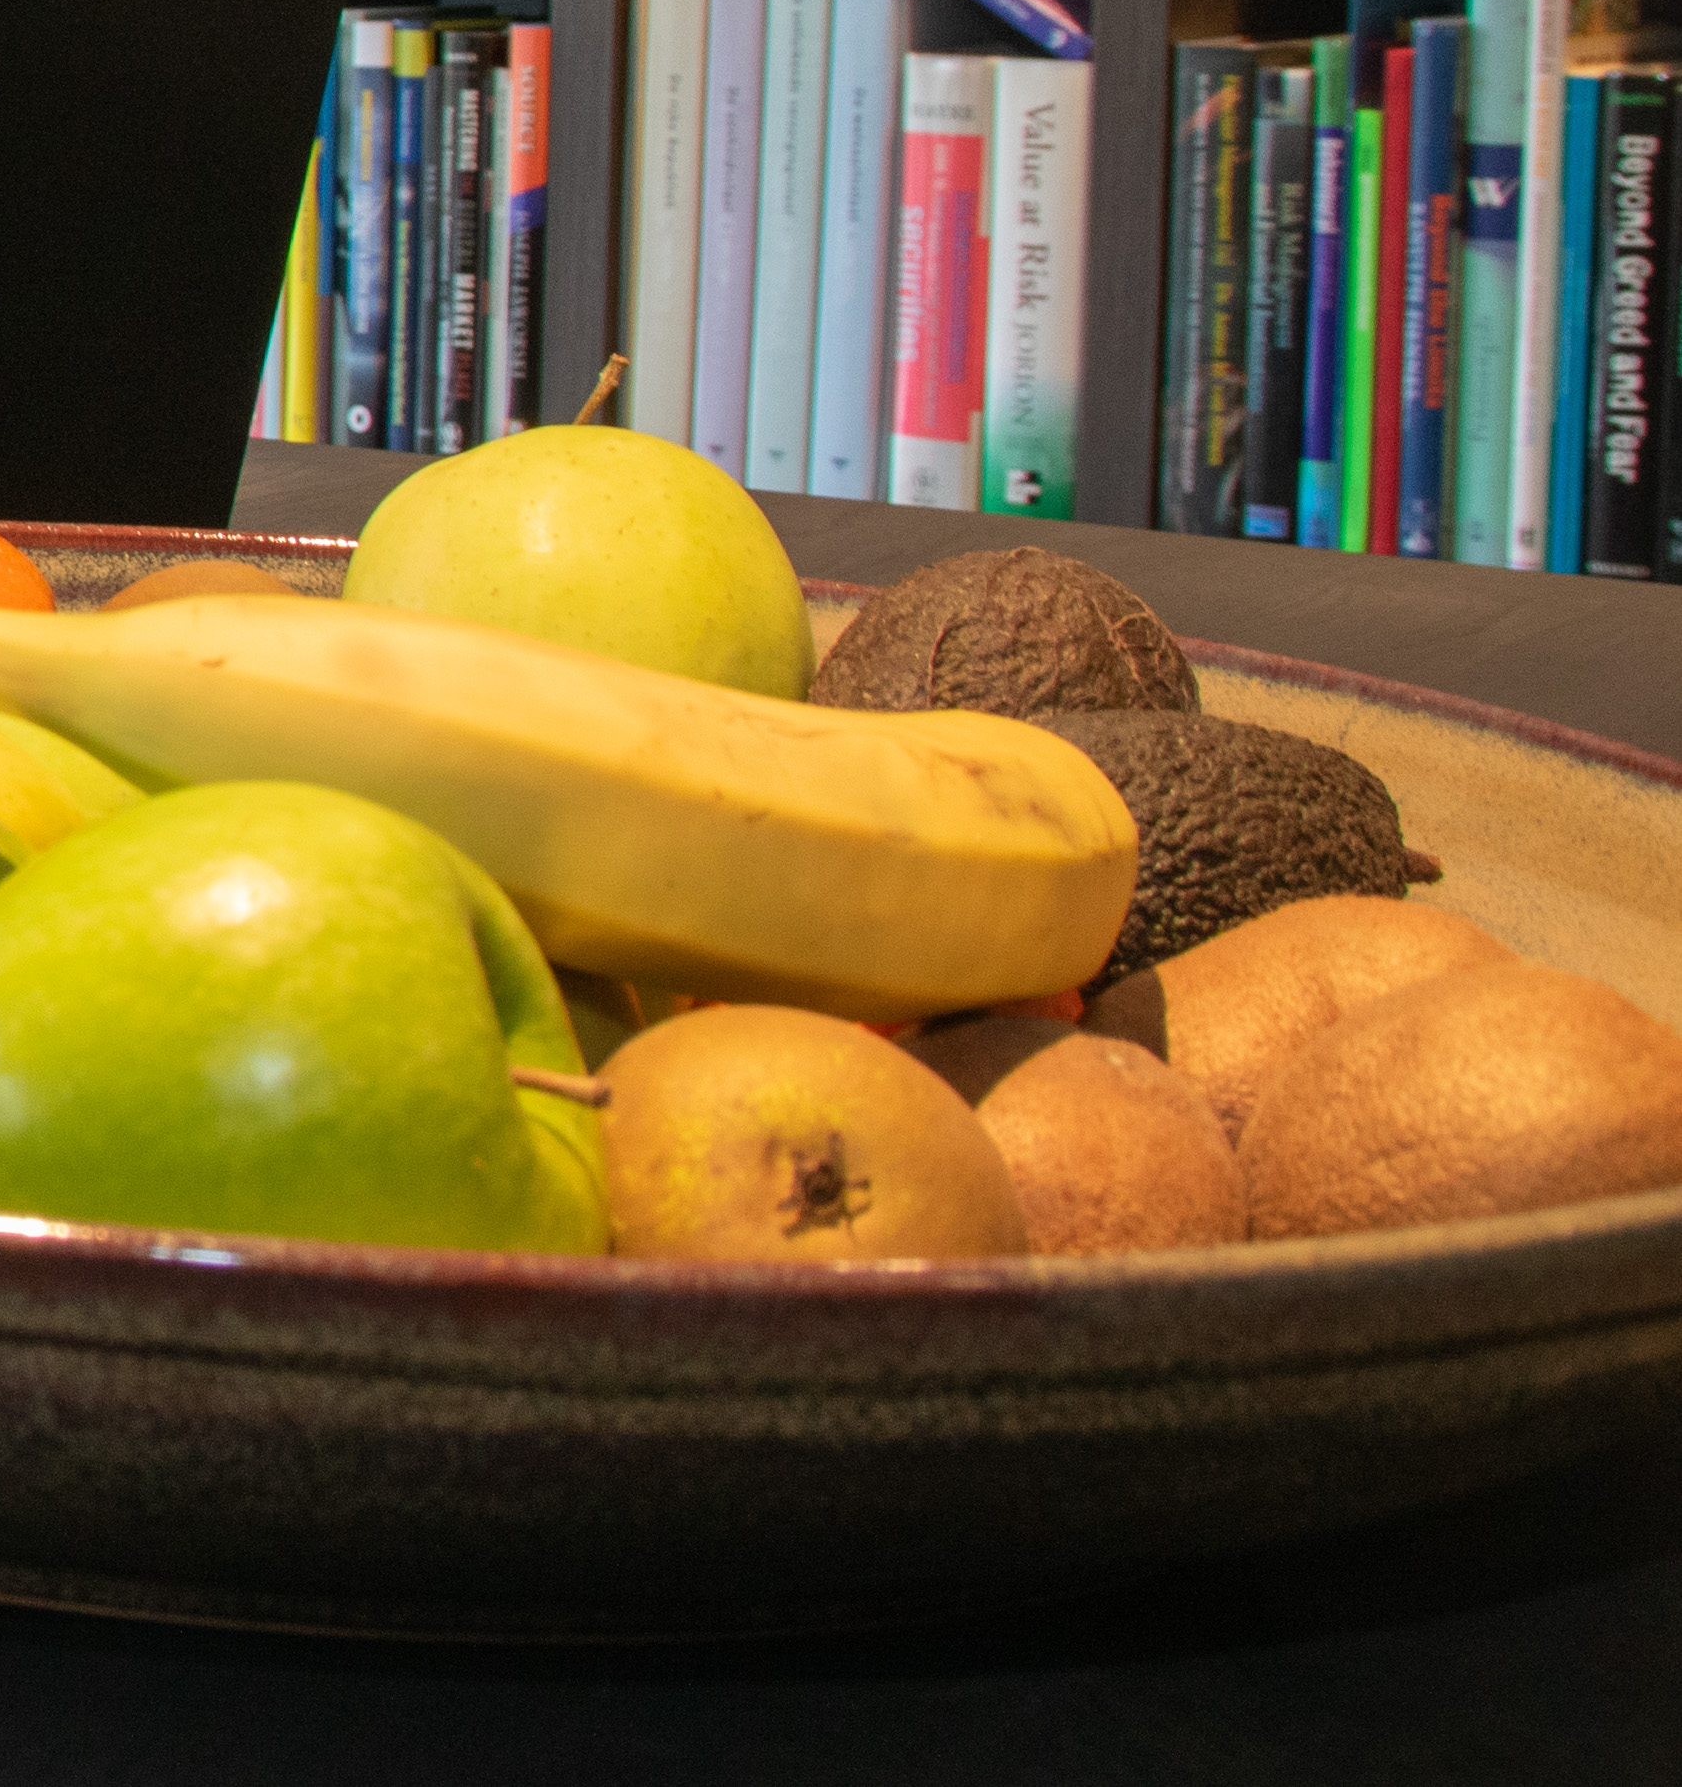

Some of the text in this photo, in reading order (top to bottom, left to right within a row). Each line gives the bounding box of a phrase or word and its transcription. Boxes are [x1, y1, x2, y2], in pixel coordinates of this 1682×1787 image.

[456, 89, 479, 172] MASTERING
[517, 65, 537, 154] SOURCE
[510, 210, 533, 379] JOSEPH JAWORSKI
[897, 205, 926, 362] securities
[1012, 102, 1057, 426] Value at Risk JORION
[1604, 133, 1662, 485] Beyond Greed and Fear
